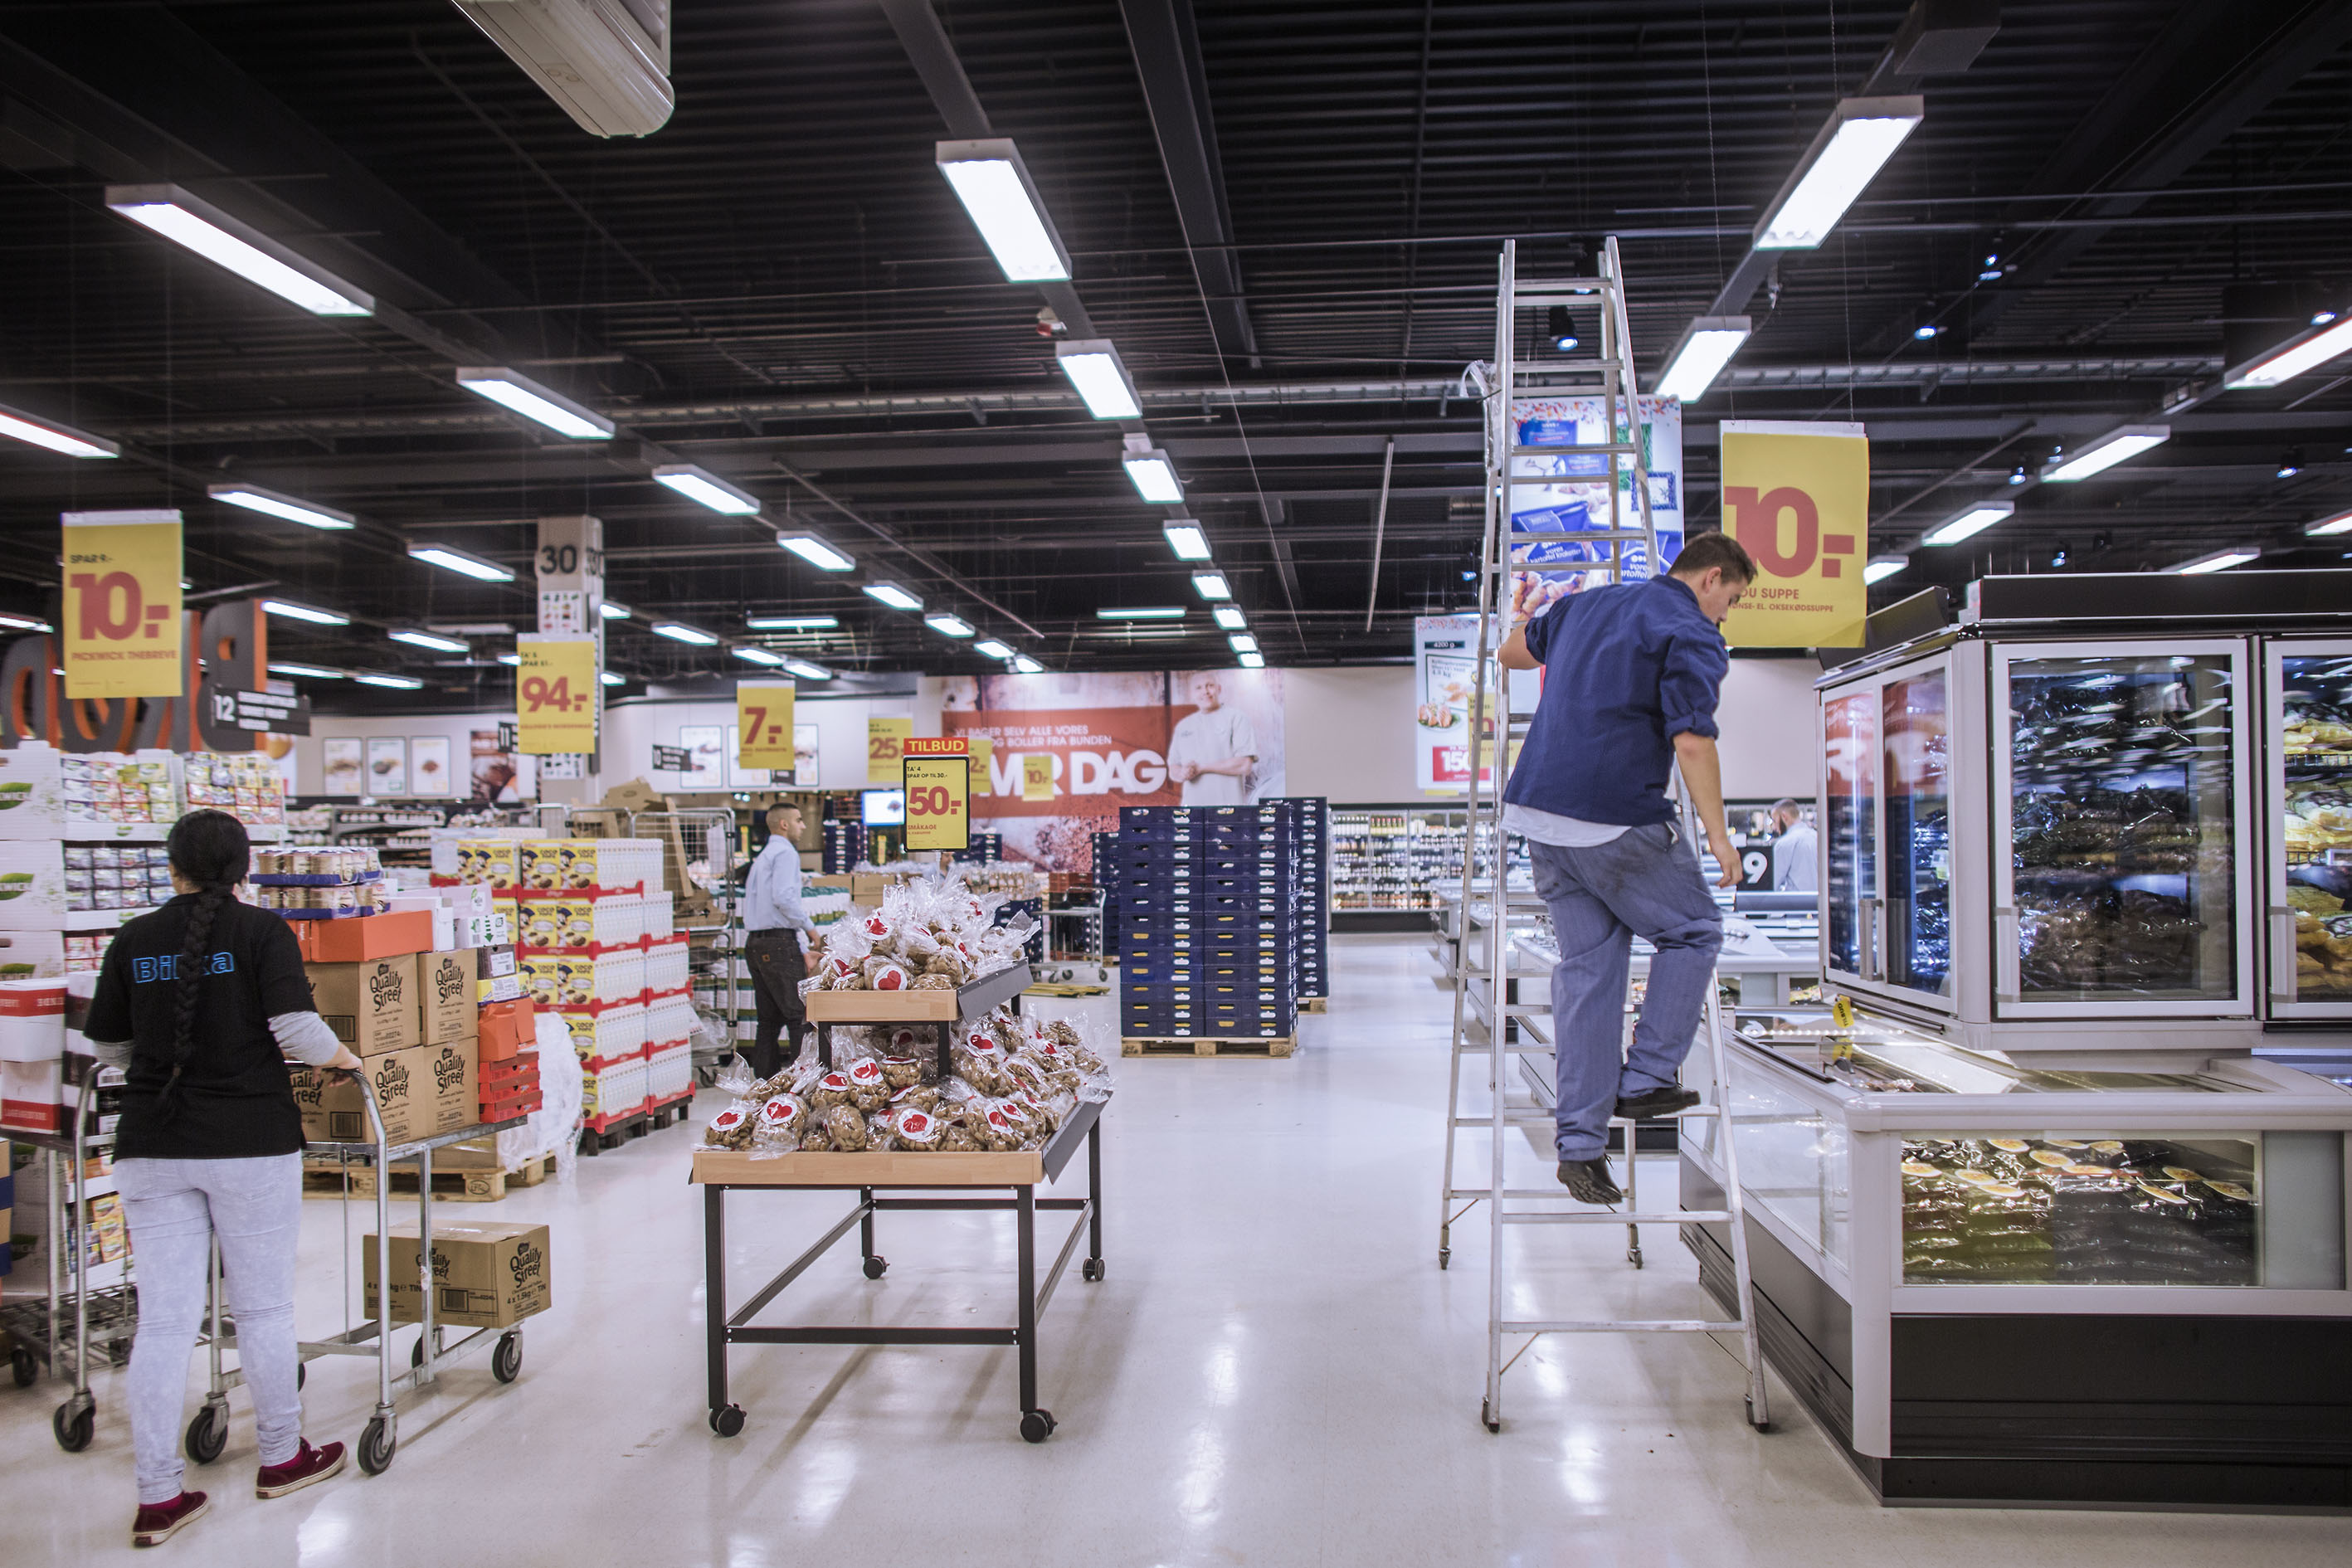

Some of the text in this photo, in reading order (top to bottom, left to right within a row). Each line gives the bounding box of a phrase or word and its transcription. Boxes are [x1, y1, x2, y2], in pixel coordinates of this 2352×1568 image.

[1724, 485, 1855, 578] 10.-
[540, 544, 577, 575] 30
[70, 571, 170, 641] 10.-
[1741, 587, 1799, 600] OU SUPPE
[521, 676, 587, 713] 94.-
[214, 694, 236, 722] 12
[745, 706, 782, 744] 7.-
[1004, 727, 1026, 737] SELV
[1030, 726, 1052, 736] ALLE
[1054, 725, 1088, 736] VORES
[908, 740, 965, 752] TILBUD
[1008, 737, 1045, 747] BOLLER
[1047, 736, 1067, 746] FRA
[1070, 735, 1112, 746] BUNDEN
[1070, 749, 1167, 796] DAG
[908, 786, 962, 816] 50.-
[1743, 852, 1768, 884] 9
[133, 952, 235, 984] Bila
[436, 966, 465, 986] Quality
[369, 971, 403, 994] Quality
[438, 981, 464, 1004] Street
[373, 987, 402, 1012] Street
[375, 1064, 410, 1089] Quality
[434, 1054, 465, 1077] Quality
[437, 1071, 465, 1094] Street
[380, 1083, 409, 1108] Street
[510, 1247, 543, 1273] Quality
[514, 1261, 542, 1288] Street
